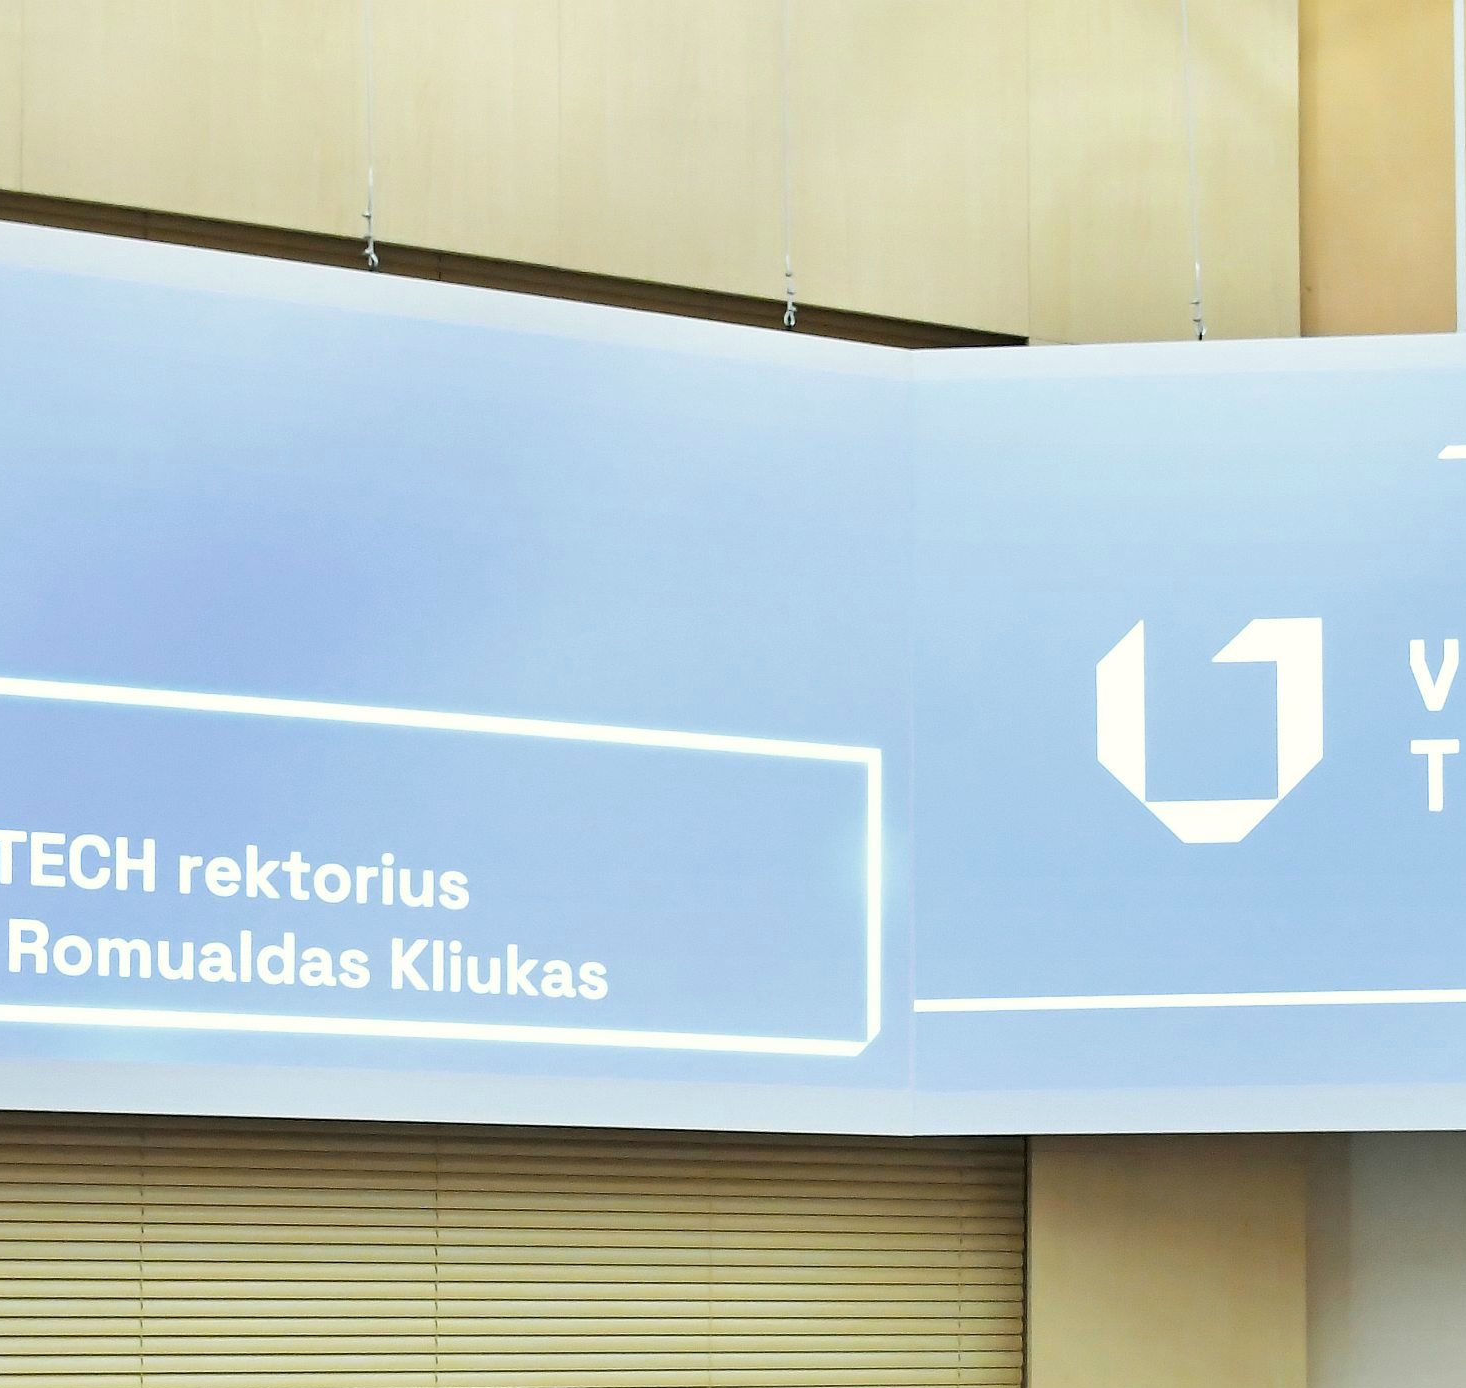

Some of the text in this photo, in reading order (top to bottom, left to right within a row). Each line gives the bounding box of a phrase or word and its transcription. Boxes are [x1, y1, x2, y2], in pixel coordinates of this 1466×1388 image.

[179, 844, 470, 910] rektorius
[8, 918, 371, 989] Romualdas
[391, 937, 608, 1000] Kliukas
